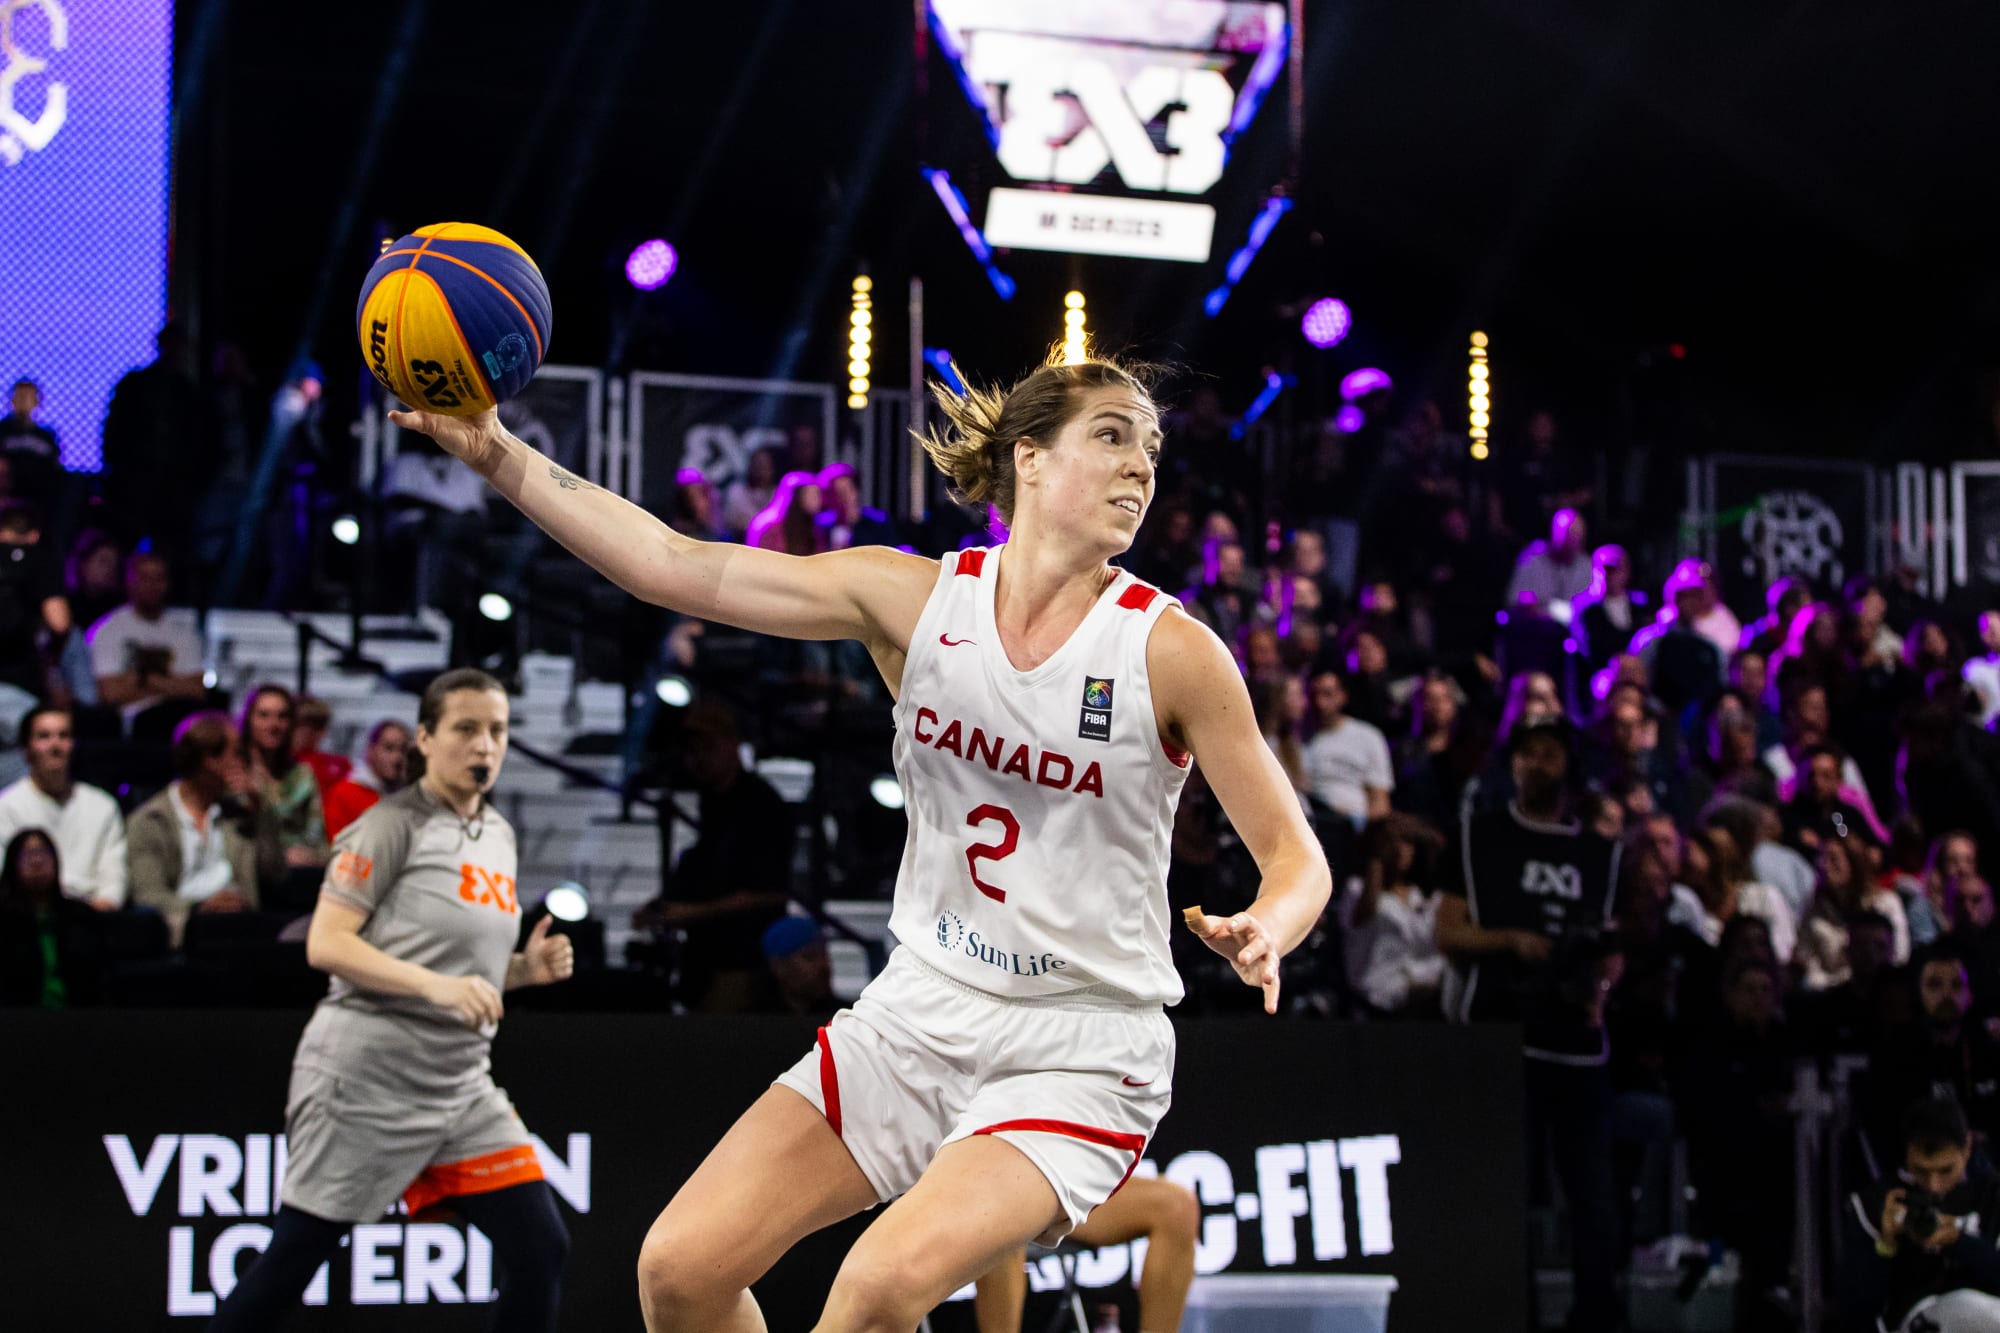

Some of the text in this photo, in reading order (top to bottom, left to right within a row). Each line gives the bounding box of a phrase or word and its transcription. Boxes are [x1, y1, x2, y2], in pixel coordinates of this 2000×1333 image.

[914, 706, 1104, 798] CANADA
[1084, 712, 1107, 726] FIBA
[965, 803, 1021, 904] 2
[965, 931, 1067, 977] Sun Life
[102, 1132, 591, 1215] VRIN
